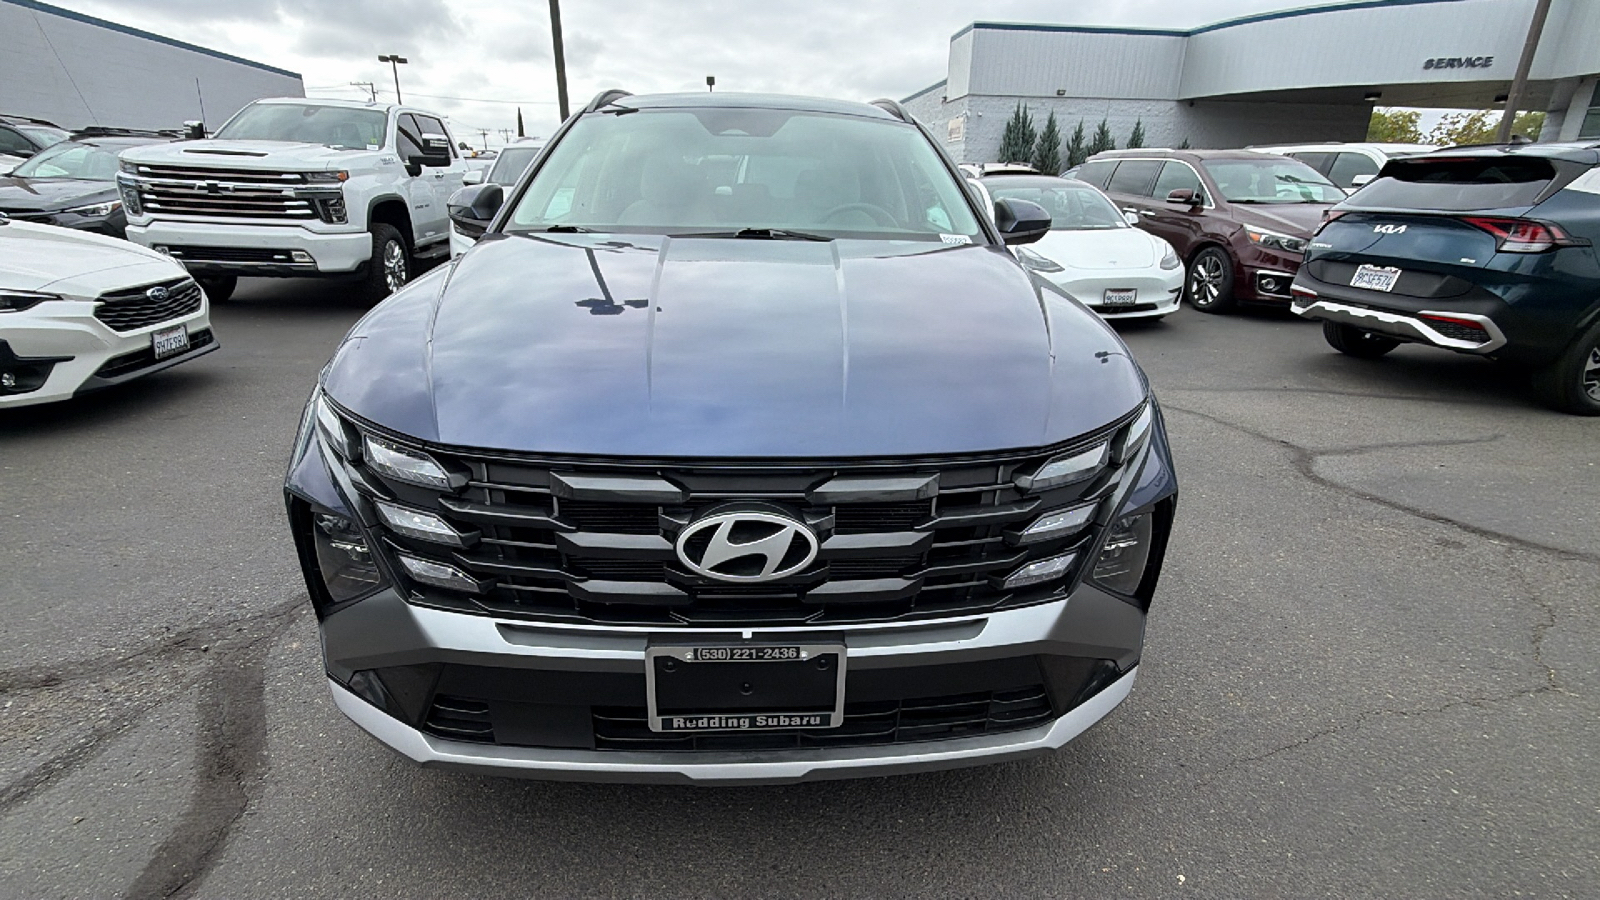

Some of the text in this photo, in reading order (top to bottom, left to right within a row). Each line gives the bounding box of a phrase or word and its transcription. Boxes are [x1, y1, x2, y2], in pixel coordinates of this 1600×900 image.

[1423, 56, 1494, 70] SERVICE
[1373, 224, 1407, 234] KIA
[697, 647, 797, 661] (530) 221-2436
[673, 715, 821, 729] Redding Subaru
